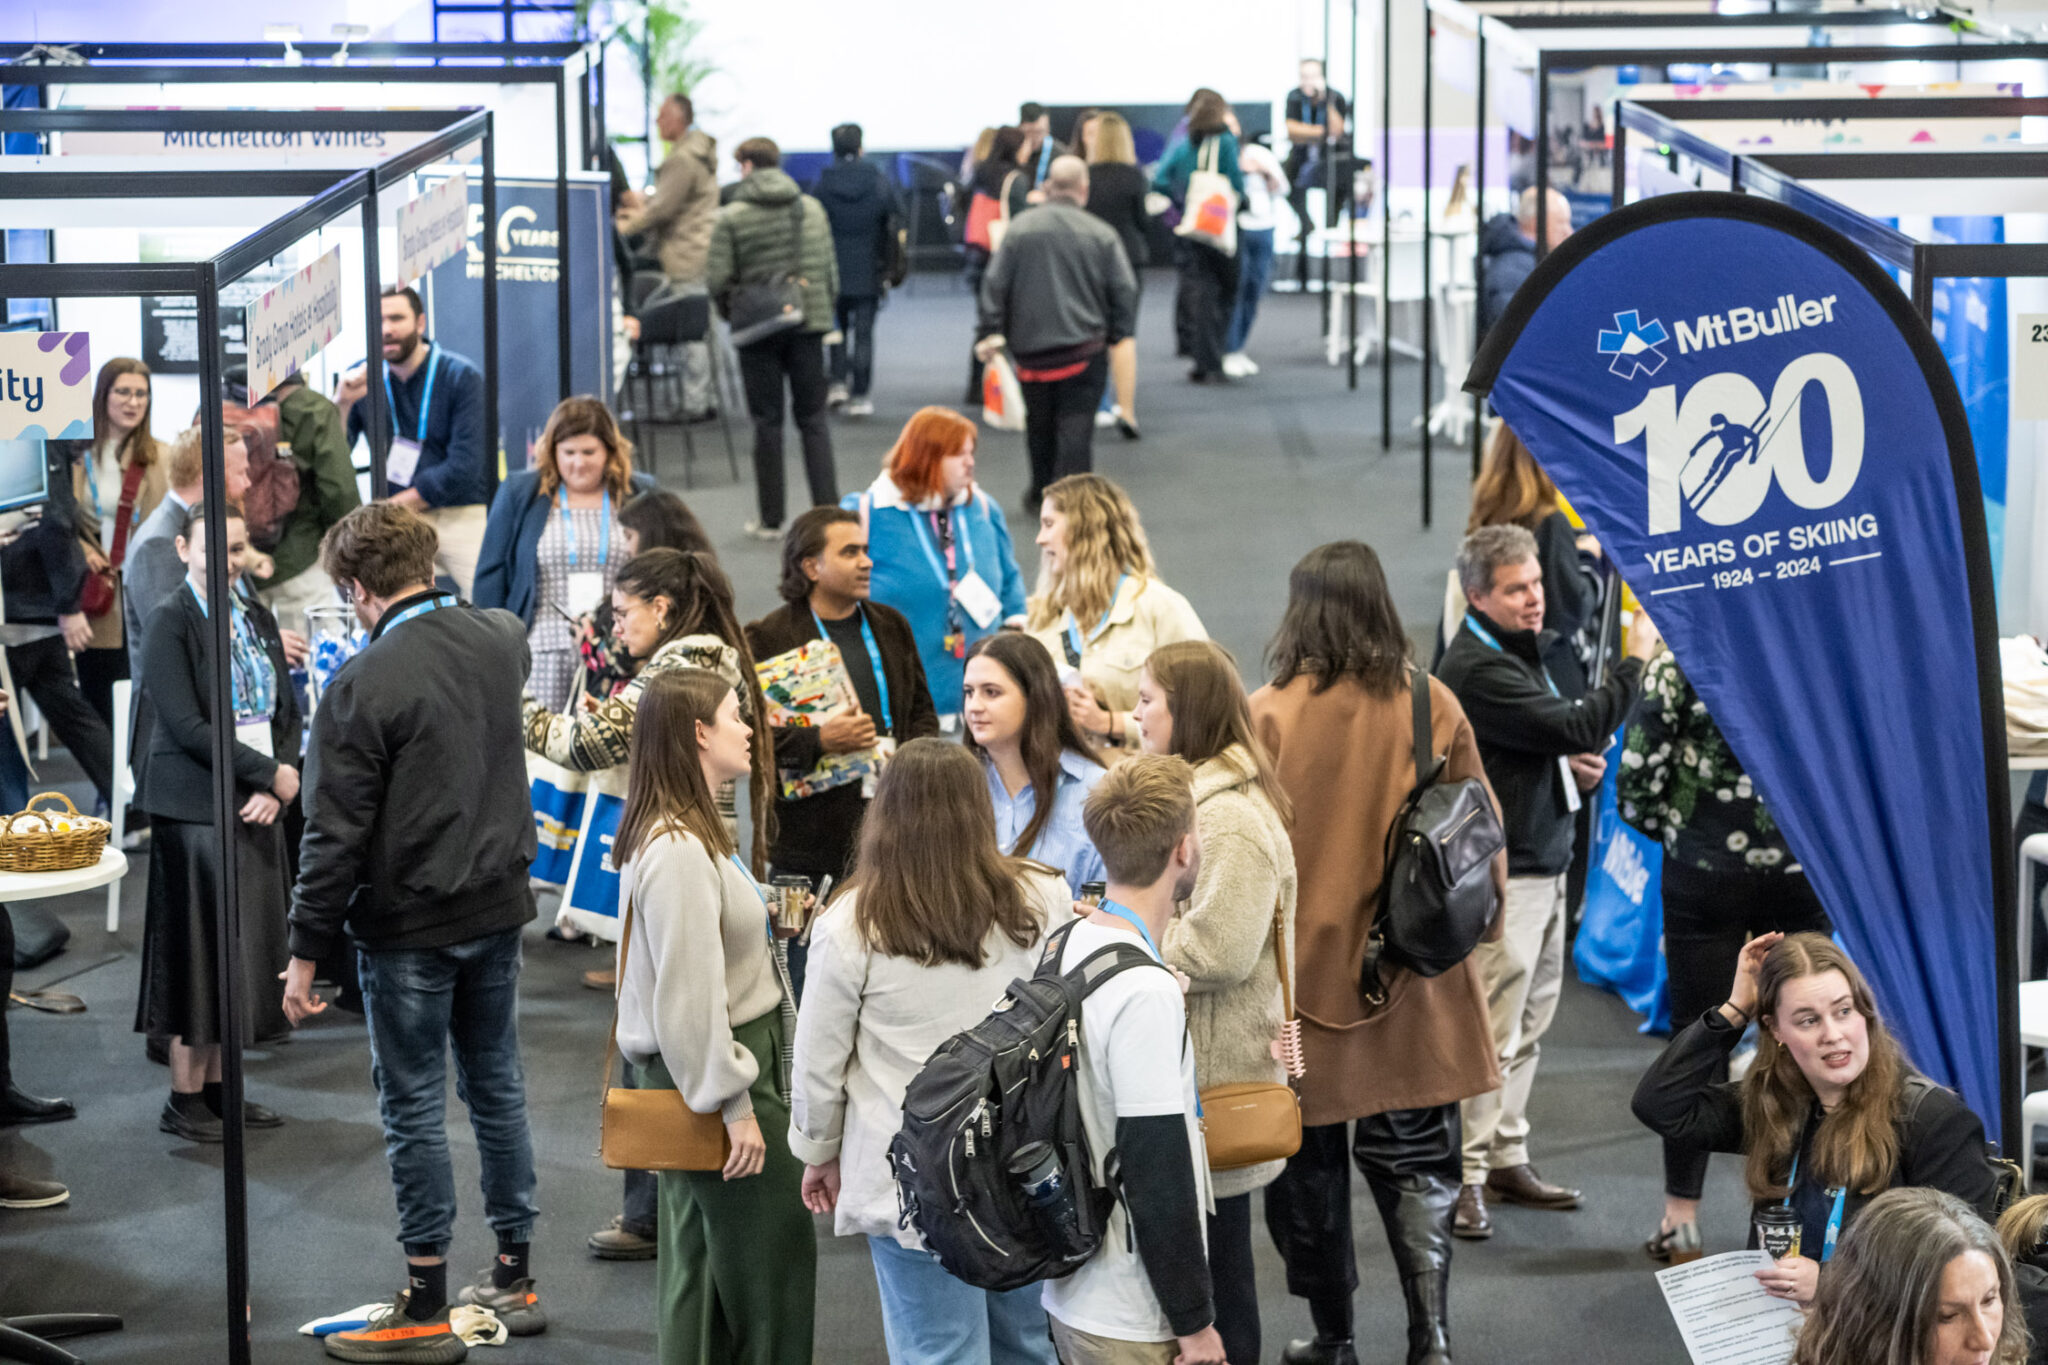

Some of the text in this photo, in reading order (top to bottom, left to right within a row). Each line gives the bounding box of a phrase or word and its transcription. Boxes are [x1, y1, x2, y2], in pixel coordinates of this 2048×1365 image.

[1613, 352, 1865, 536] 100
[1645, 513, 1879, 574] YEARS OF SKIING
[1711, 566, 1754, 590] 1924
[1776, 556, 1821, 580] 2024
